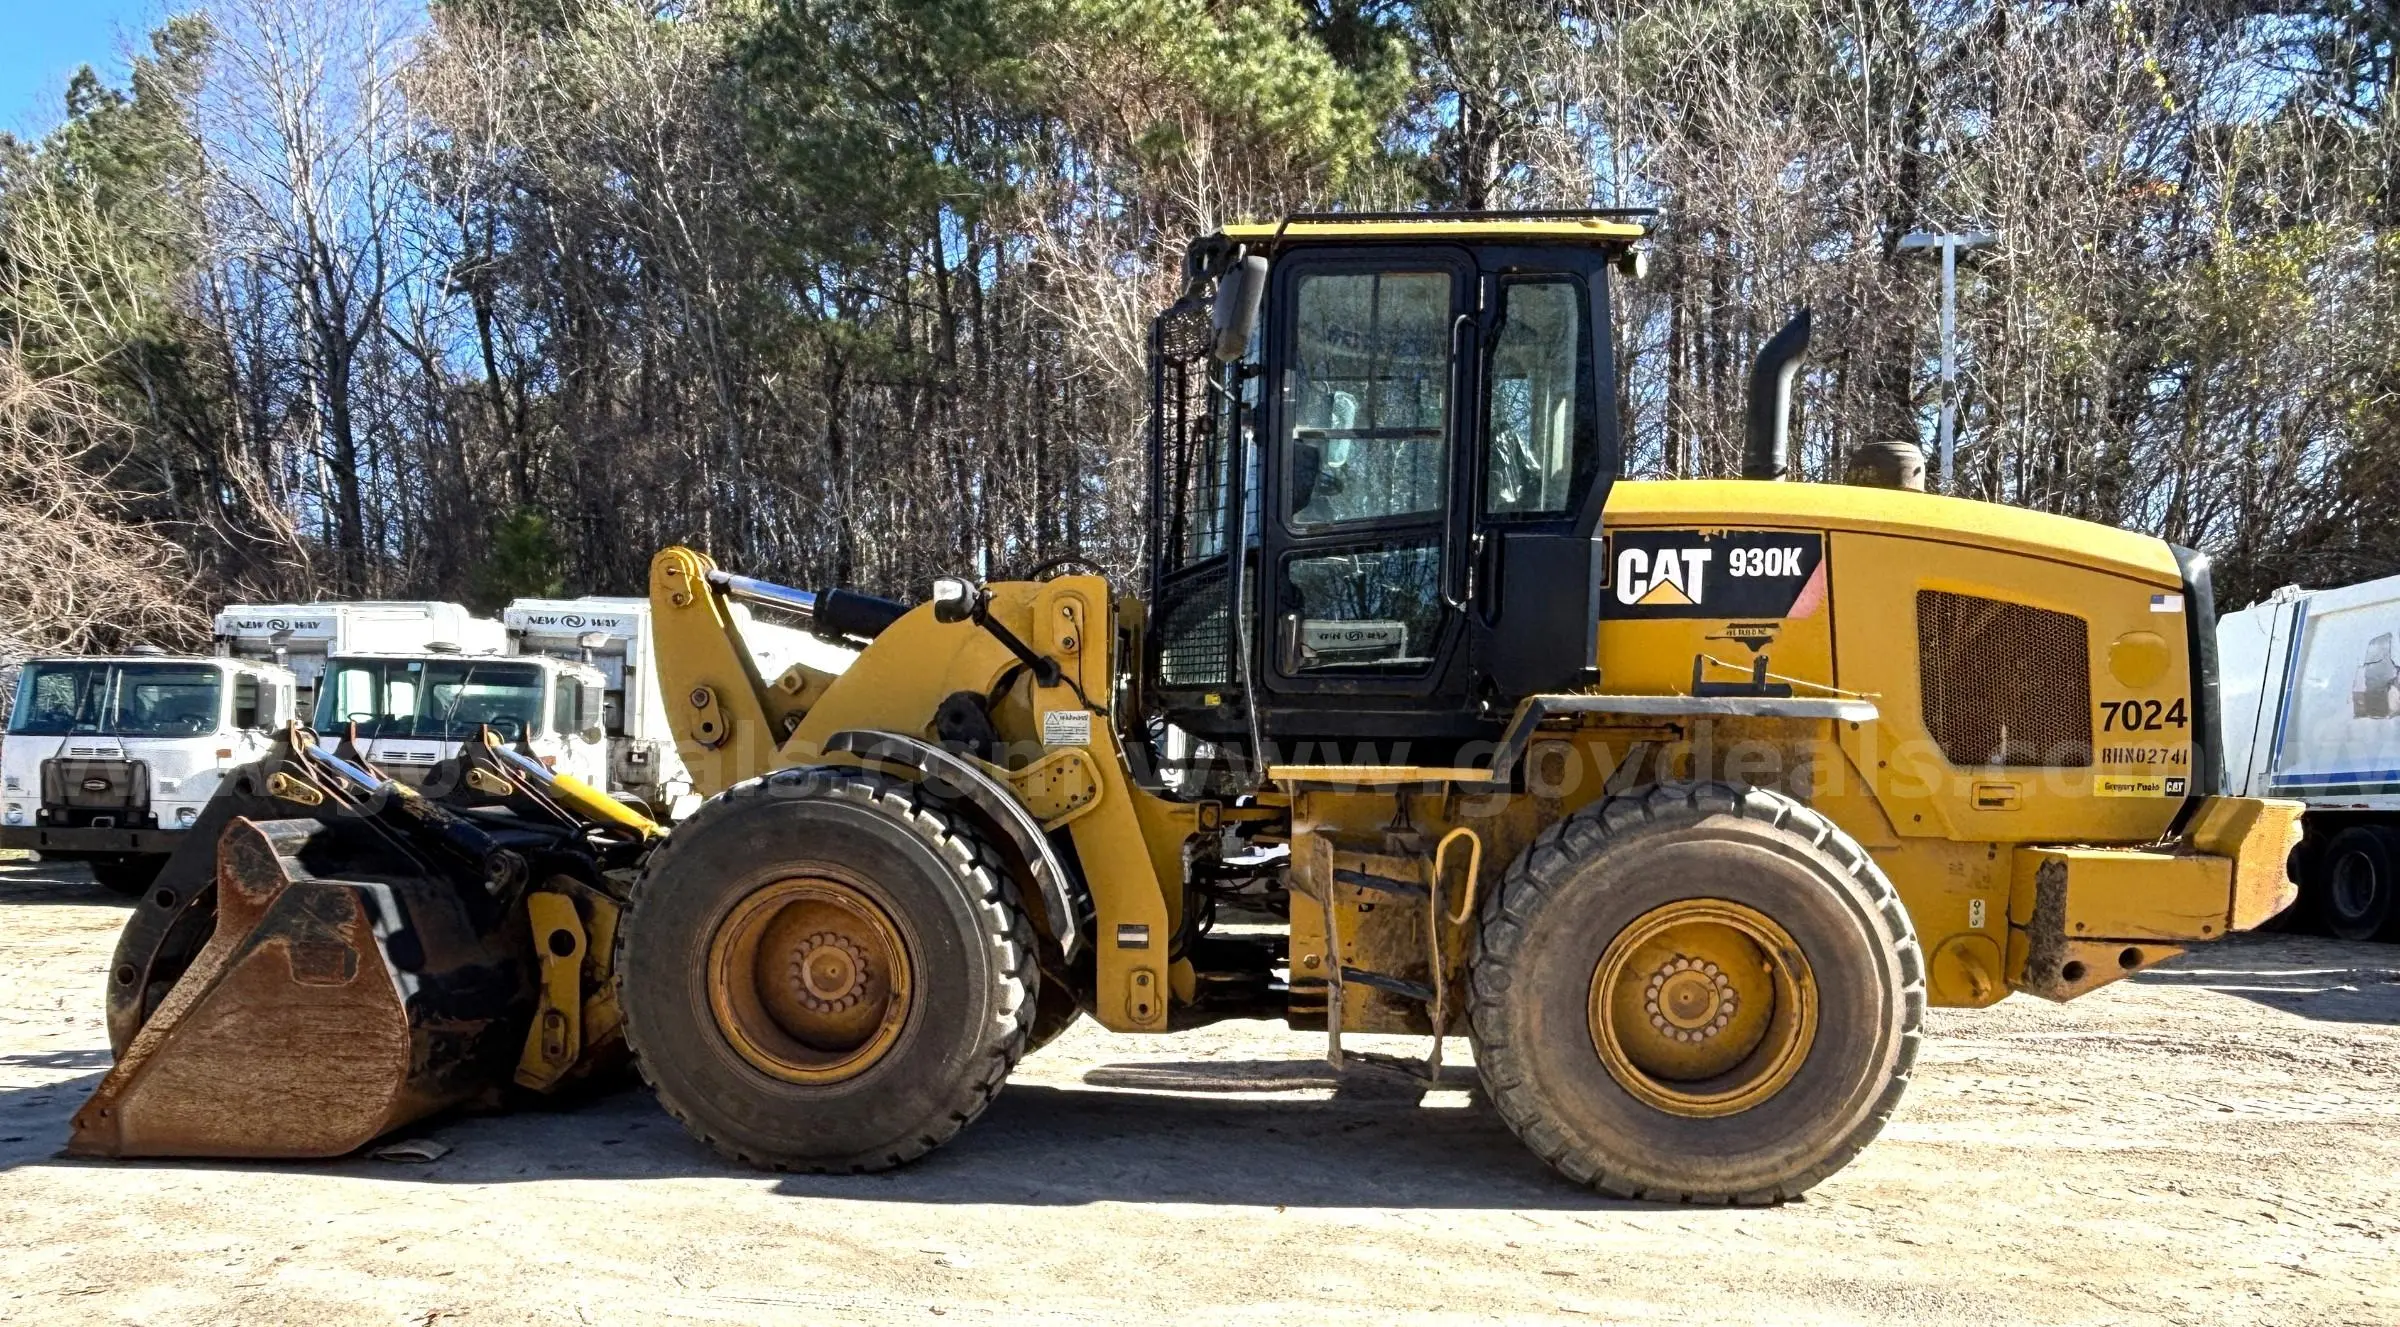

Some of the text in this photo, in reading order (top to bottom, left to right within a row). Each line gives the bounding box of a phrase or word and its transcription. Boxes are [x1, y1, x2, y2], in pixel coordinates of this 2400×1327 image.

[1616, 547, 1803, 605] CAT 930K
[237, 621, 264, 629] NEW
[527, 615, 558, 625] NEW
[591, 618, 620, 627] WAY
[2100, 697, 2188, 732] 7024
[2102, 747, 2188, 765] RHN02741
[2166, 781, 2184, 793] CAT
